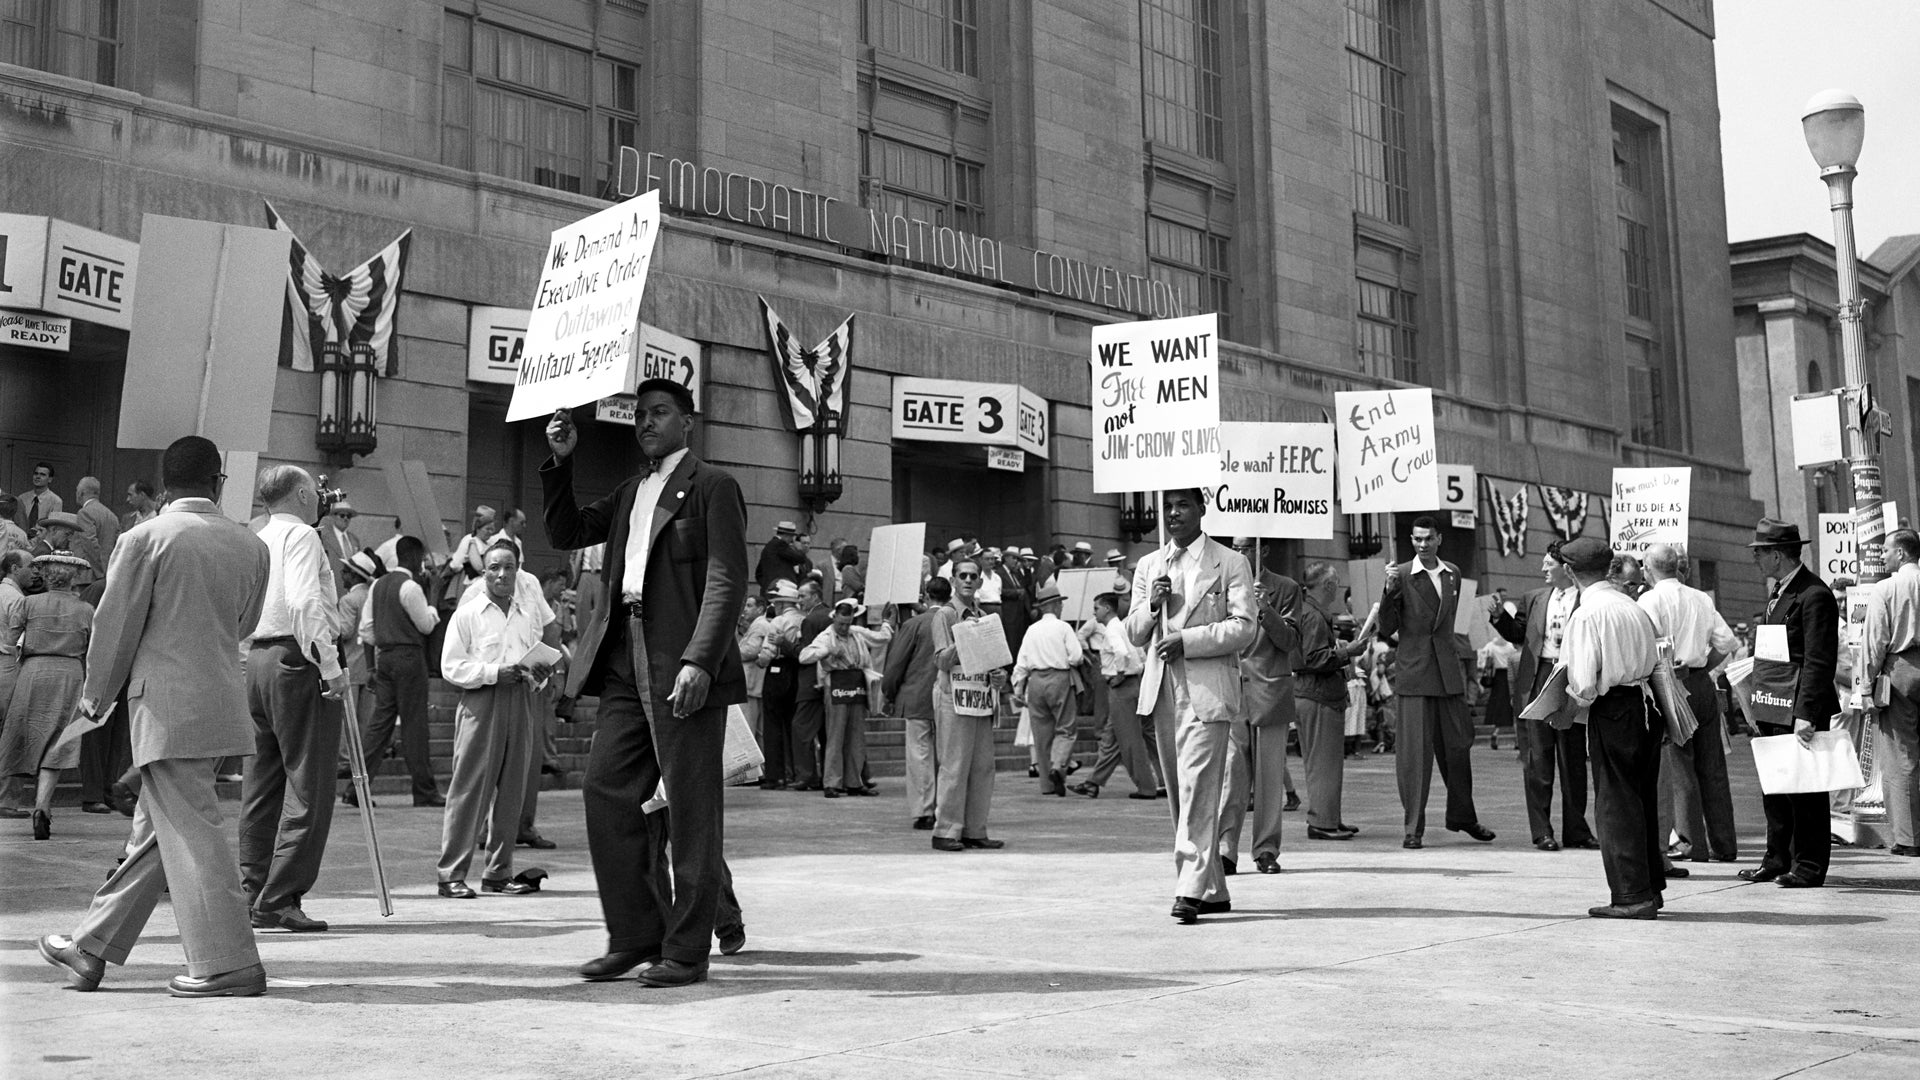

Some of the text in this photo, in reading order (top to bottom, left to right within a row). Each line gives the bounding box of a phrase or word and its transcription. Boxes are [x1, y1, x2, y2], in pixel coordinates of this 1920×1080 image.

[551, 212, 648, 271] We Demand An
[618, 145, 1183, 319] DEMOCRATIC NATIONAL CONVENTION
[58, 256, 125, 303] GATE
[607, 254, 646, 288] Order
[555, 297, 633, 341] Outlawing
[10, 329, 60, 344] READY
[489, 335, 524, 363] GA
[1098, 333, 1211, 368] WE WANT
[644, 352, 694, 392] GATE 2
[1157, 375, 1208, 404] MEN
[610, 410, 635, 420] READ
[903, 396, 1004, 434] GATE 3
[1104, 403, 1137, 434] not
[1349, 392, 1397, 431] End
[1020, 409, 1045, 447] GATE 3
[1101, 426, 1222, 461] JIM-CROW SLAVES
[1244, 451, 1275, 472] want
[1354, 448, 1434, 502] Jim Crow
[1447, 475, 1464, 503] 5
[1615, 482, 1623, 500] If
[1616, 502, 1682, 513] LET US DIE AS
[1634, 518, 1679, 527] FREE MEN
[1612, 541, 1622, 551] AS
[1835, 540, 1851, 554] JI
[1828, 559, 1857, 575] CRO
[1755, 690, 1793, 708] Tribune
